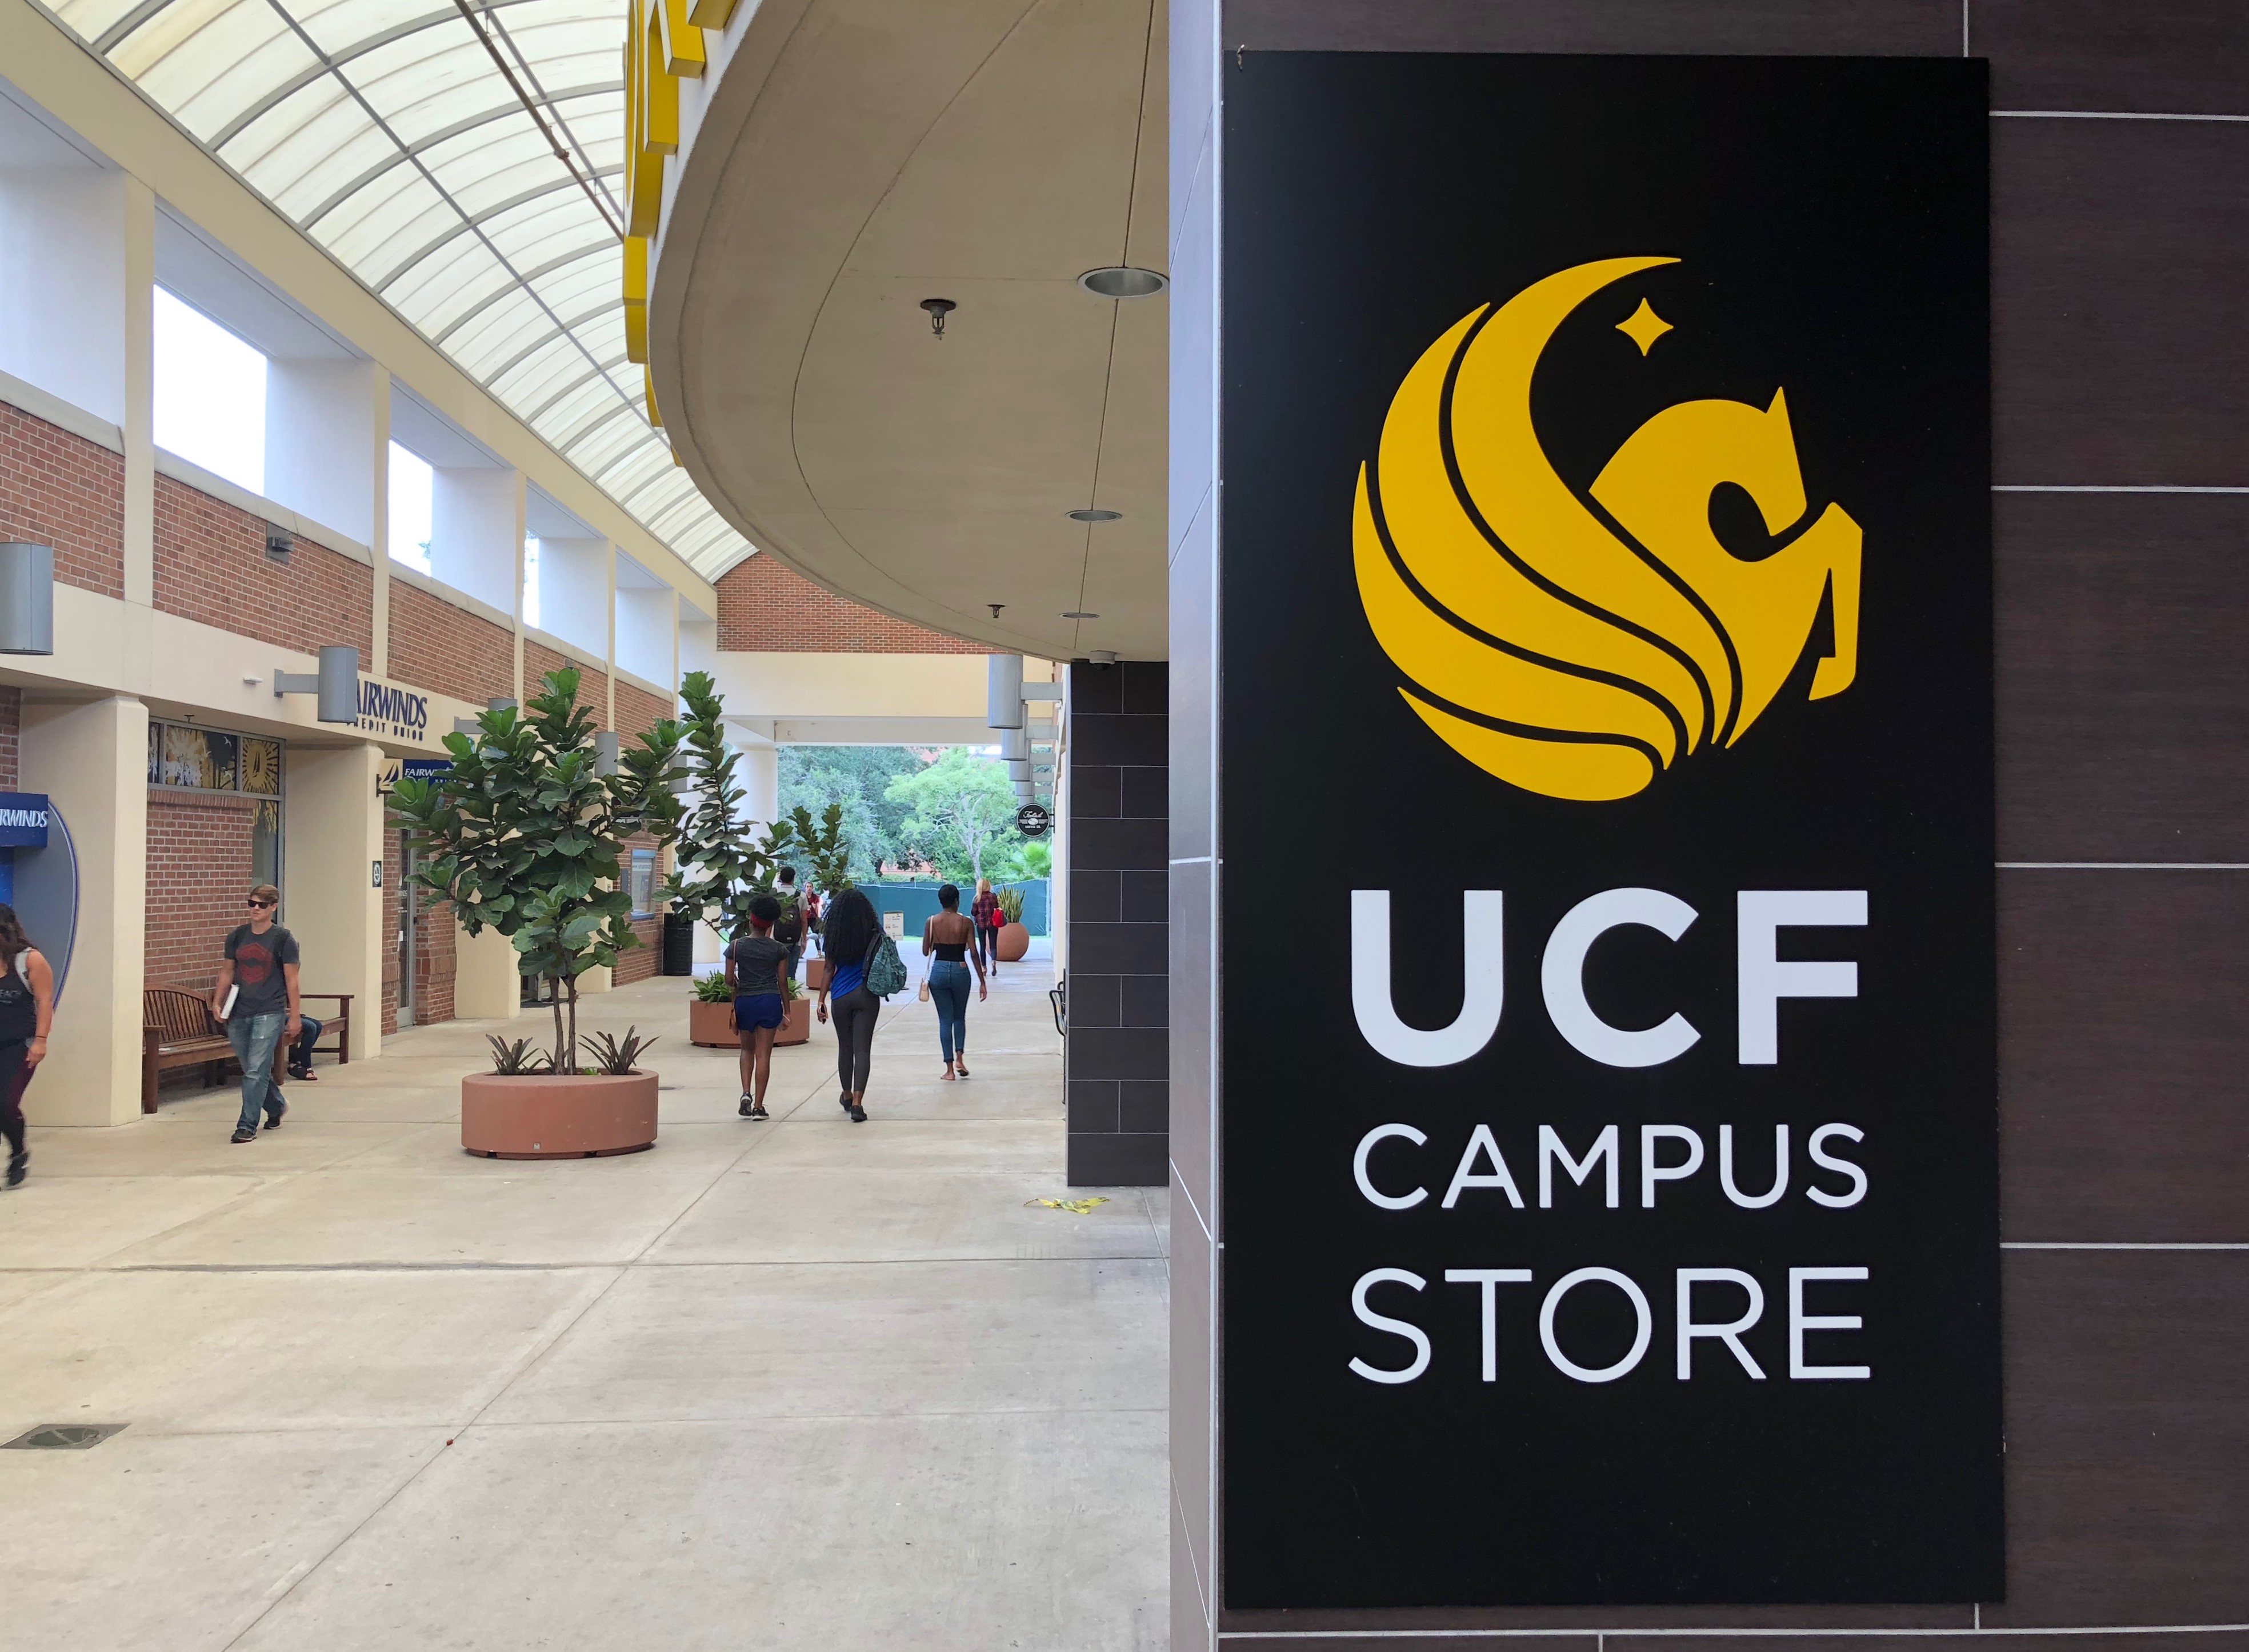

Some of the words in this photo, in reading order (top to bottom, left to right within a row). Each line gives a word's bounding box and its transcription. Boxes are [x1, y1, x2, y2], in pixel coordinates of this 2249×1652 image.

[394, 725, 423, 741] UNION
[405, 768, 439, 777] FAIRW
[1350, 888, 1868, 1067] UCF
[1353, 1123, 1868, 1210] CAMPUS
[1348, 1267, 1871, 1384] STORE
